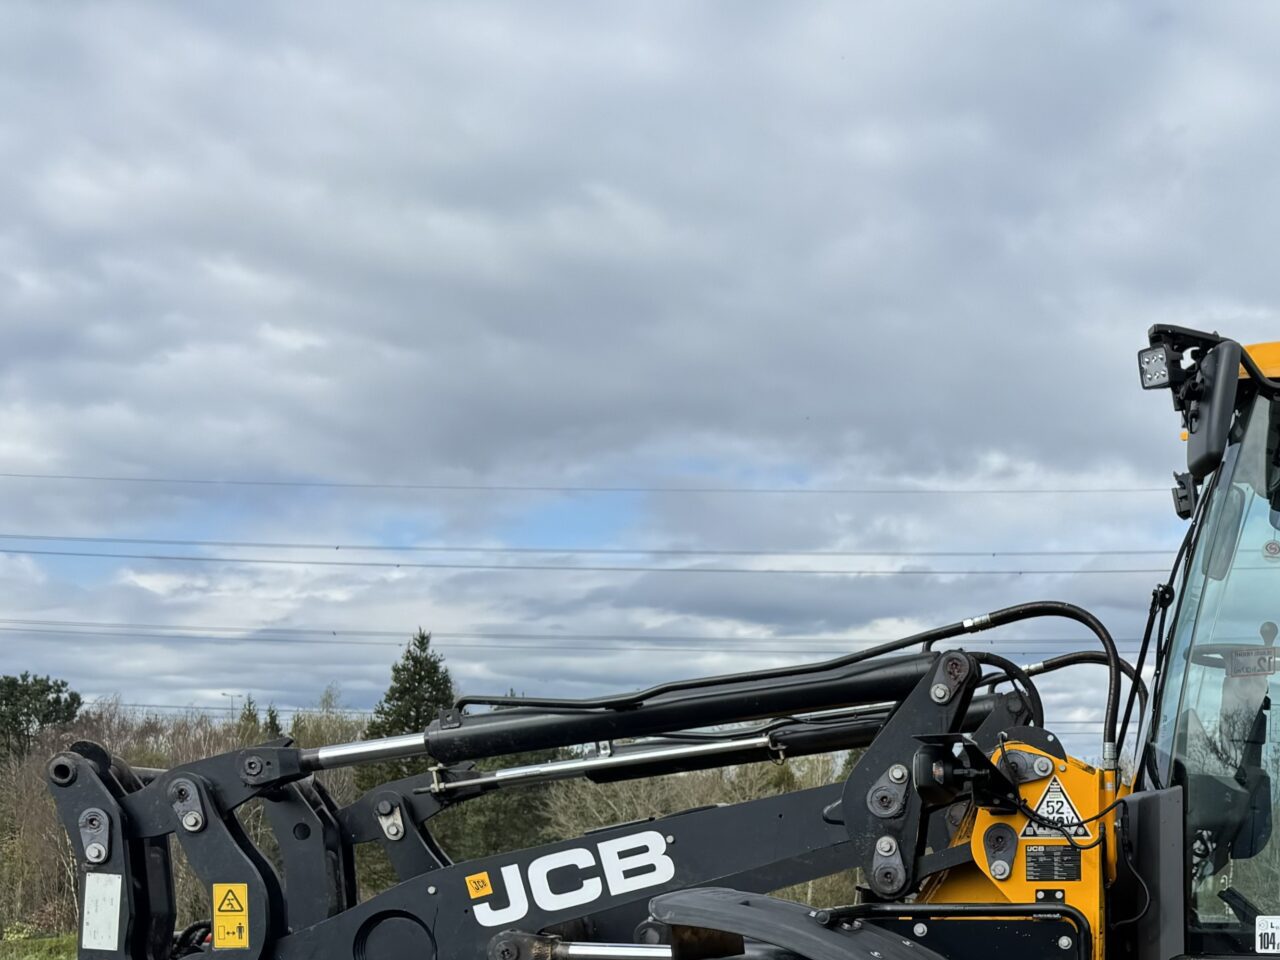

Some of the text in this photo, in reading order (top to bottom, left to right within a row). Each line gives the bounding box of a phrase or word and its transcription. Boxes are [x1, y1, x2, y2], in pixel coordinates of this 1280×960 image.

[1046, 801, 1065, 815] 52
[472, 830, 675, 927] JCB
[1259, 932, 1276, 950] 104
